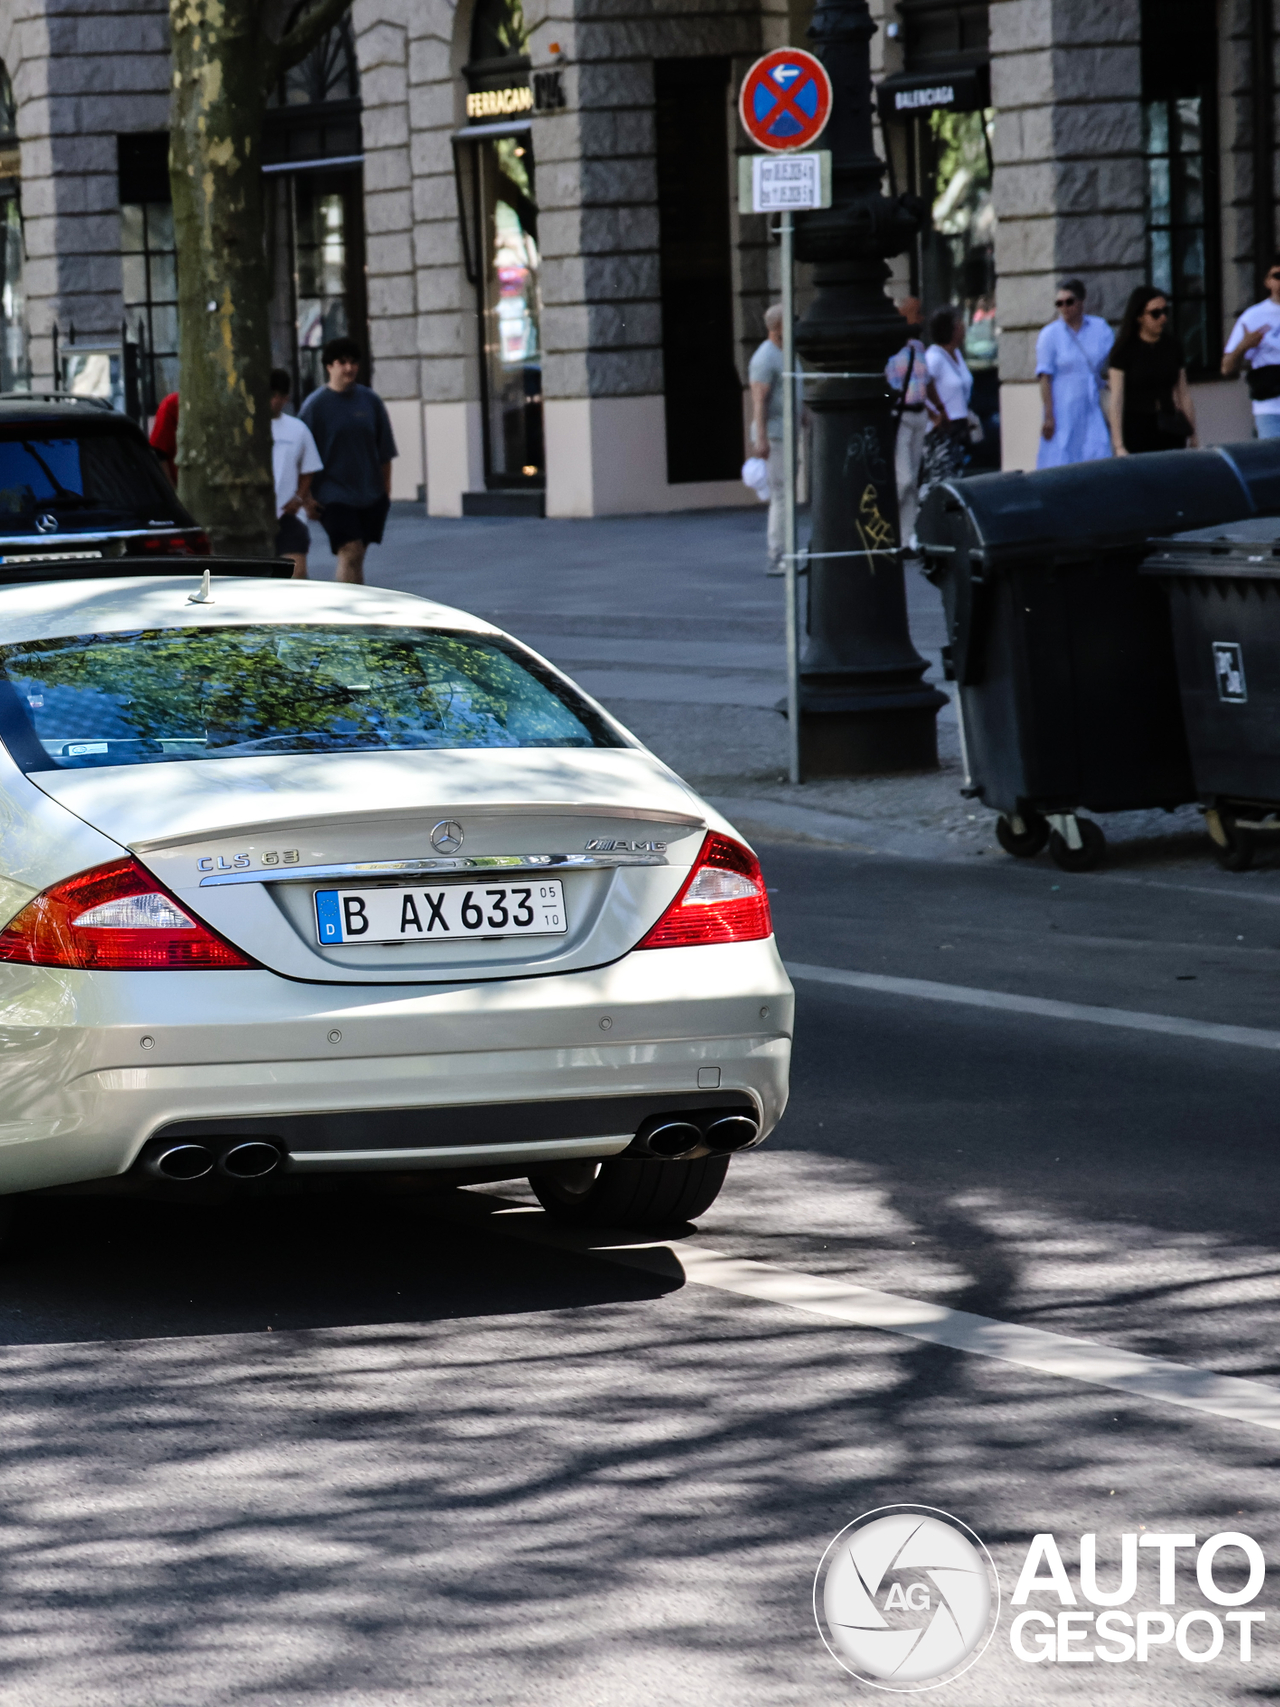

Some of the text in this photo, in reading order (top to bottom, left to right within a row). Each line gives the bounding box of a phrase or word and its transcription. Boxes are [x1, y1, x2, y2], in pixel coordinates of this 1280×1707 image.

[466, 86, 535, 118] FERRAGAM
[611, 839, 668, 852] AMG
[197, 849, 300, 872] CLS 63
[539, 886, 557, 898] 05
[343, 887, 535, 936] B AX 633
[544, 914, 560, 926] 10
[325, 923, 336, 936] D
